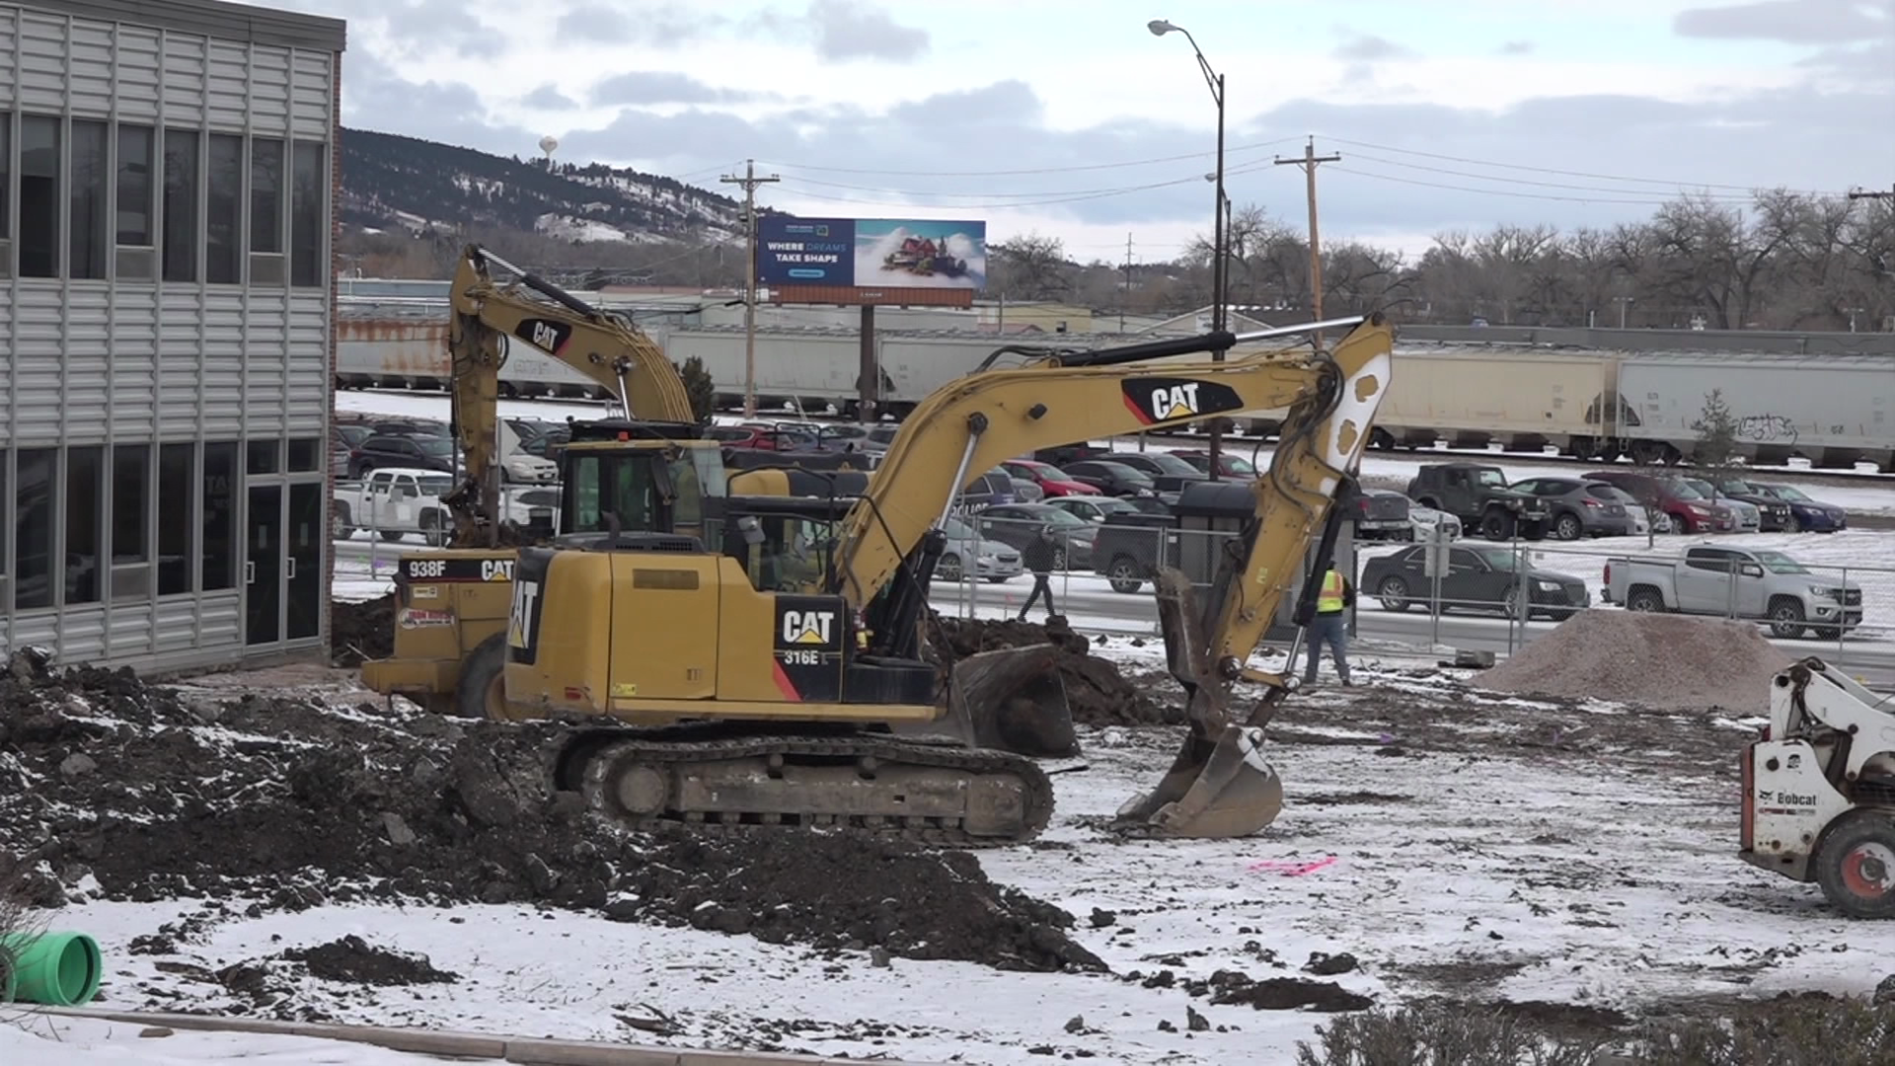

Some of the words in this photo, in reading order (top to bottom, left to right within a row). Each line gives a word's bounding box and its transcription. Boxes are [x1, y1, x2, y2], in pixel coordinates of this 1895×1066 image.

[767, 242, 804, 251] WHERE
[806, 243, 847, 252] DREAMS
[775, 253, 802, 262] TAKE
[804, 254, 838, 263] SHAPE
[533, 321, 558, 351] CAT
[1151, 382, 1199, 420] CAT
[409, 560, 446, 577] 938F
[481, 560, 514, 581] CAT
[510, 580, 538, 649] AT
[783, 610, 834, 643] CAT
[784, 650, 819, 665] 316E
[1777, 792, 1816, 806] Bobcat
